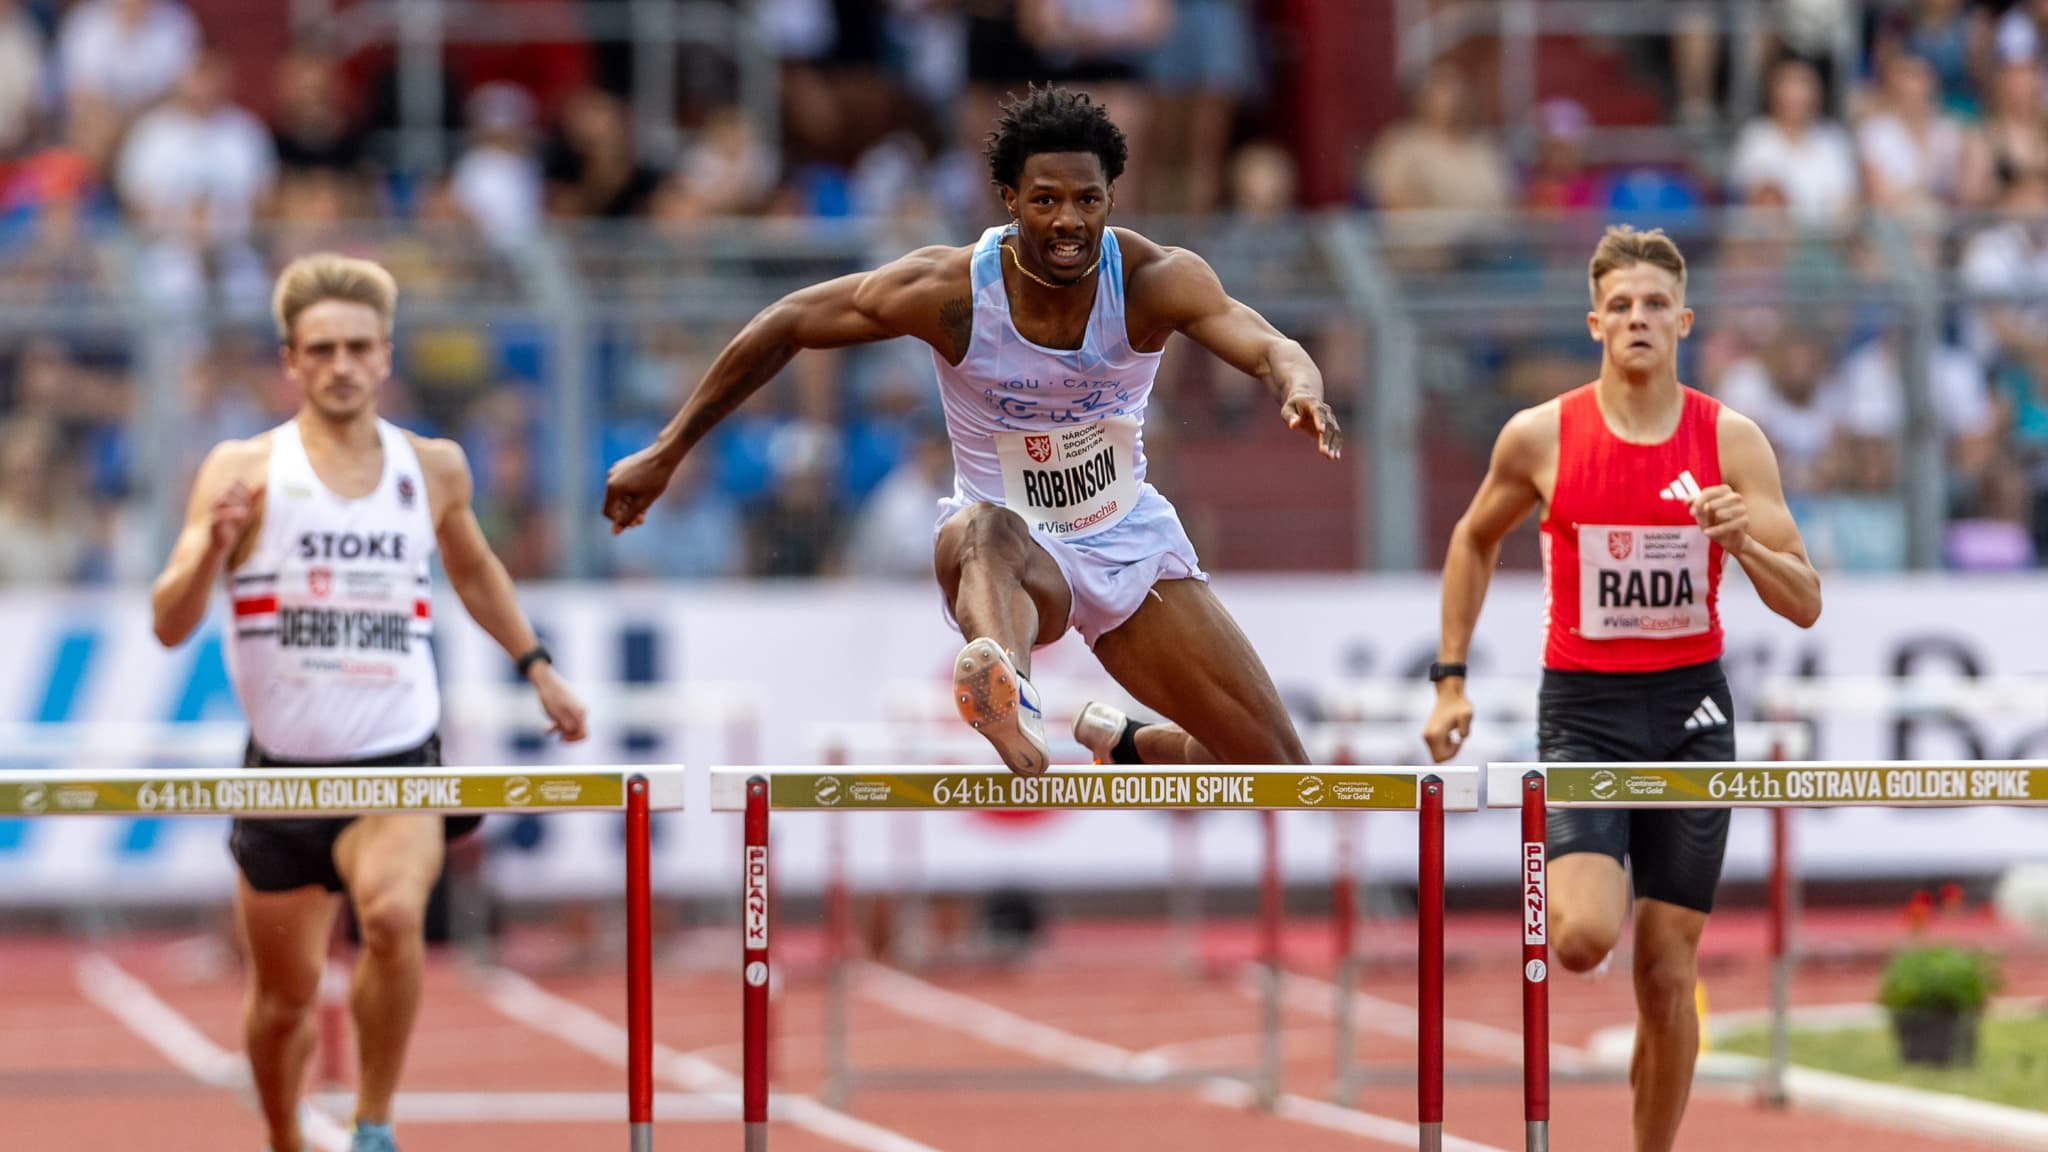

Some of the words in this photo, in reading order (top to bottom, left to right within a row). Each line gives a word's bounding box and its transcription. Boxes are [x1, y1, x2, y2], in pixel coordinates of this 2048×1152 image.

[1062, 422, 1098, 441] NÁRODNÍ
[1063, 426, 1106, 450] SPORTOVNÍ
[1066, 437, 1104, 459] AGENTURA
[1023, 446, 1117, 509] ROBINSON
[1038, 500, 1119, 534] #VisitCzechia
[300, 533, 405, 560] STOKE
[1598, 568, 1694, 608] RADA
[279, 607, 411, 655] DERBYSHIRE
[136, 780, 211, 810] 64th
[215, 779, 314, 809] OSTRAVA
[316, 777, 398, 808] GOLDEN
[402, 776, 462, 808] SPIKE
[932, 776, 1006, 805] 64th
[1010, 776, 1107, 804] OSTRAVA
[1111, 776, 1191, 804] GOLDEN
[1196, 776, 1255, 804] SPIKE
[1332, 785, 1375, 793] Continental
[1336, 793, 1352, 801] Tour
[1352, 793, 1371, 801] Gold
[1708, 772, 1783, 799] 64th
[1786, 770, 1883, 799] OSTRAVA
[1885, 770, 1967, 798] GOLDEN
[1970, 769, 2031, 798] SPIKE
[749, 850, 765, 940] POLANIK
[1526, 845, 1544, 936] POLANIK
